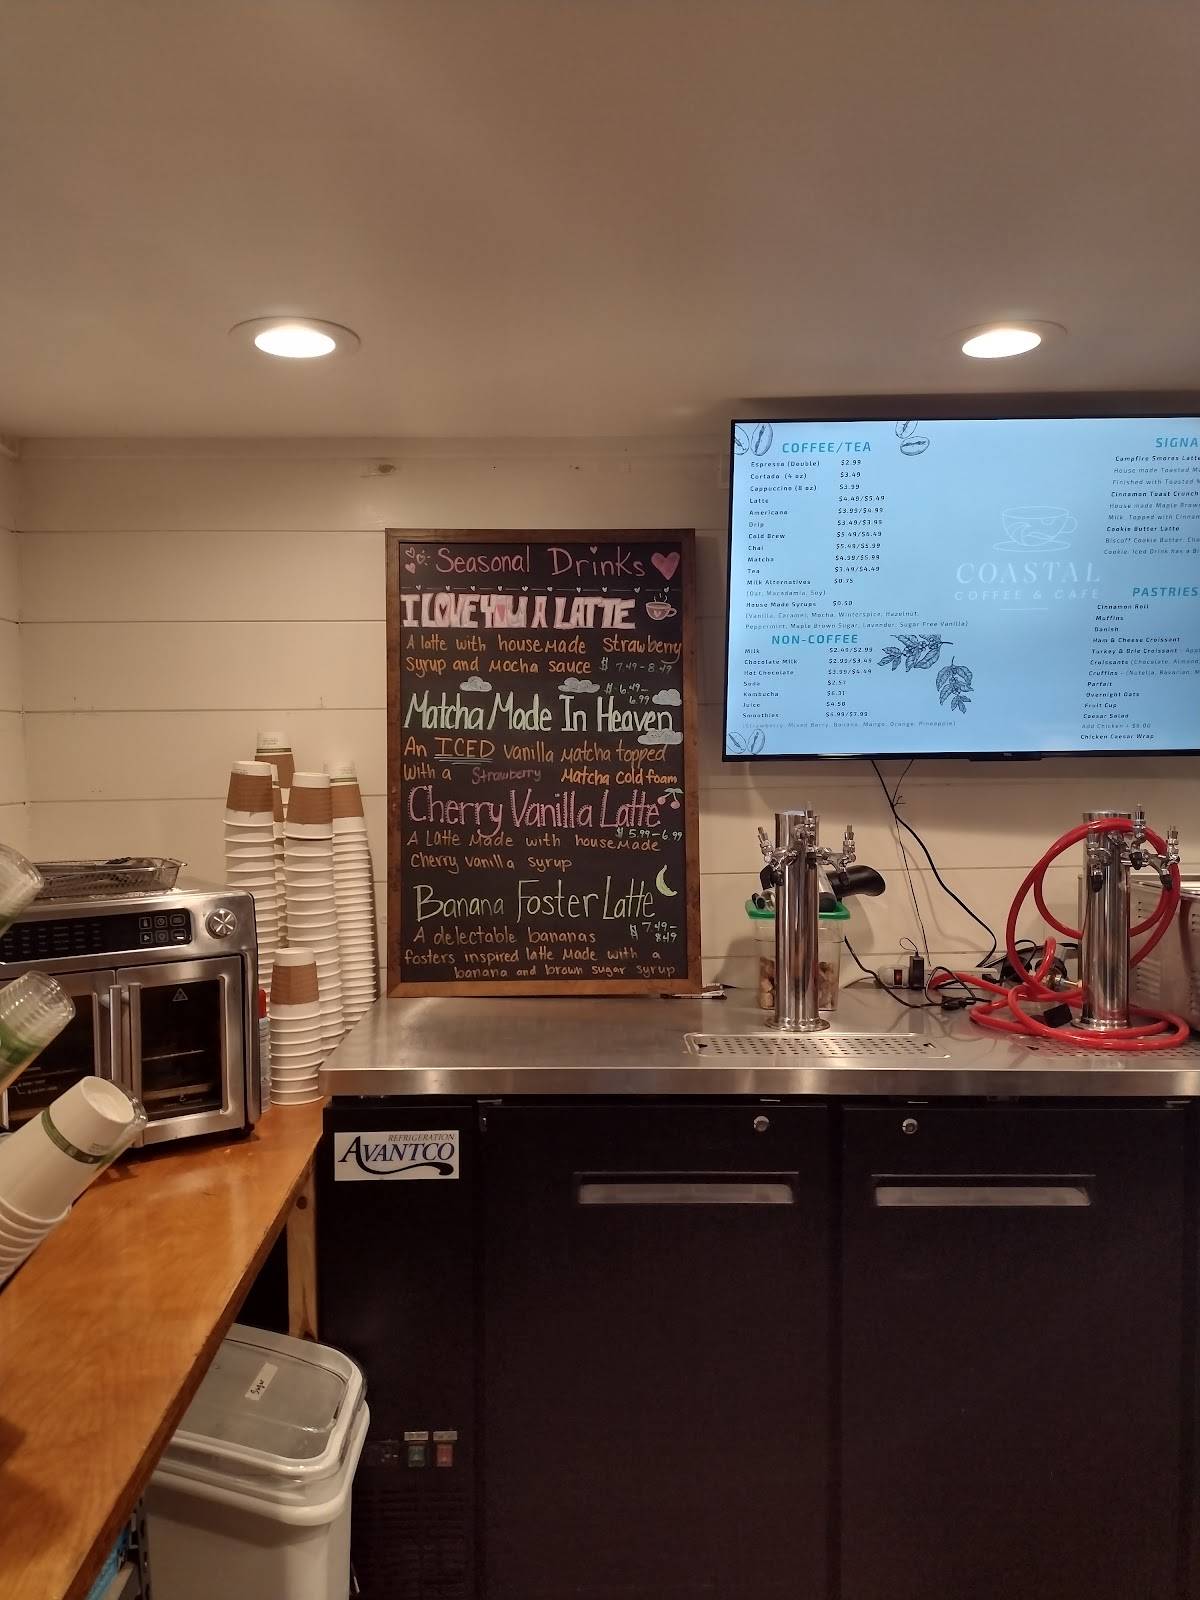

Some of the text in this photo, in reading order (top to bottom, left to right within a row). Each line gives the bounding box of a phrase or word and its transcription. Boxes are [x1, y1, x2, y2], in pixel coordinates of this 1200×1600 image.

[782, 442, 871, 453] COFFEE/TEA
[435, 545, 647, 577] Seasonal Drinks
[955, 561, 1100, 584] COASTAL
[954, 590, 1024, 601] COFFEE
[1032, 590, 1042, 600] &
[1132, 587, 1199, 597] PASTRIES
[400, 592, 636, 630] I LOVE YOU A LATTE
[406, 636, 415, 650] A
[421, 633, 447, 650] latte
[456, 635, 486, 652] with
[771, 634, 859, 645] NON-COFFEE
[453, 657, 479, 672] and
[548, 659, 592, 674] sauce
[403, 688, 674, 732] Matcha Made In Heaven
[403, 737, 427, 758] An
[434, 737, 495, 758] ICED
[615, 739, 667, 768] topped
[442, 769, 451, 780] a
[560, 768, 610, 785] Matcha
[646, 769, 678, 784] foam
[407, 784, 661, 839] Cherry Vanilla Latte
[406, 832, 418, 846] A
[525, 831, 561, 847] with
[527, 856, 572, 873] syrup
[412, 875, 656, 923] Banana Foster Latte
[412, 926, 597, 945] A delectable bananas
[404, 949, 456, 966] fosters
[464, 950, 519, 968] inspired
[525, 948, 555, 961] latte
[607, 949, 638, 961] with
[652, 951, 661, 960] a
[454, 964, 676, 980] banana and brown sugar syrup
[388, 1133, 455, 1142] REFRIGERATION
[337, 1135, 455, 1163] AVANTCO
